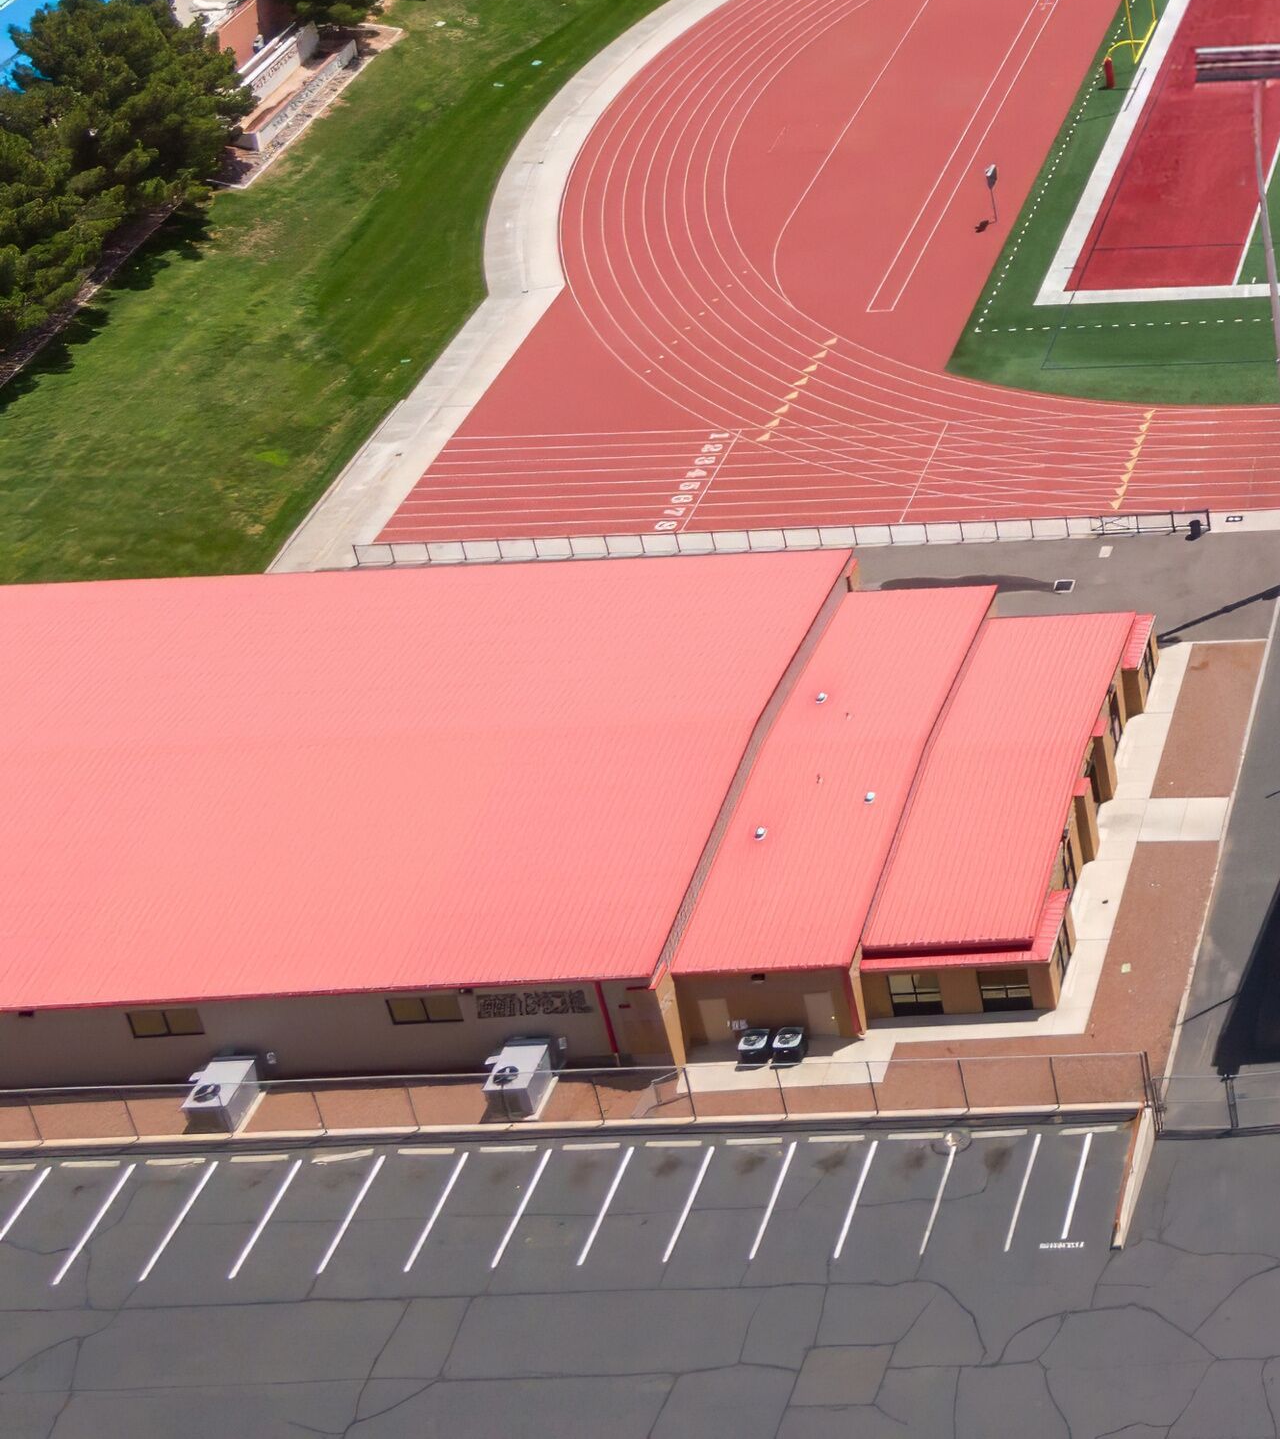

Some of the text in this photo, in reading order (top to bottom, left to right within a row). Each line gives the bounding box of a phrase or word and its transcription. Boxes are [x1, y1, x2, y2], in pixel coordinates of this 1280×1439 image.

[685, 468, 707, 478] 4
[678, 481, 701, 491] 5
[671, 494, 694, 504] 6
[663, 507, 686, 516] 7
[654, 520, 678, 531] 8
